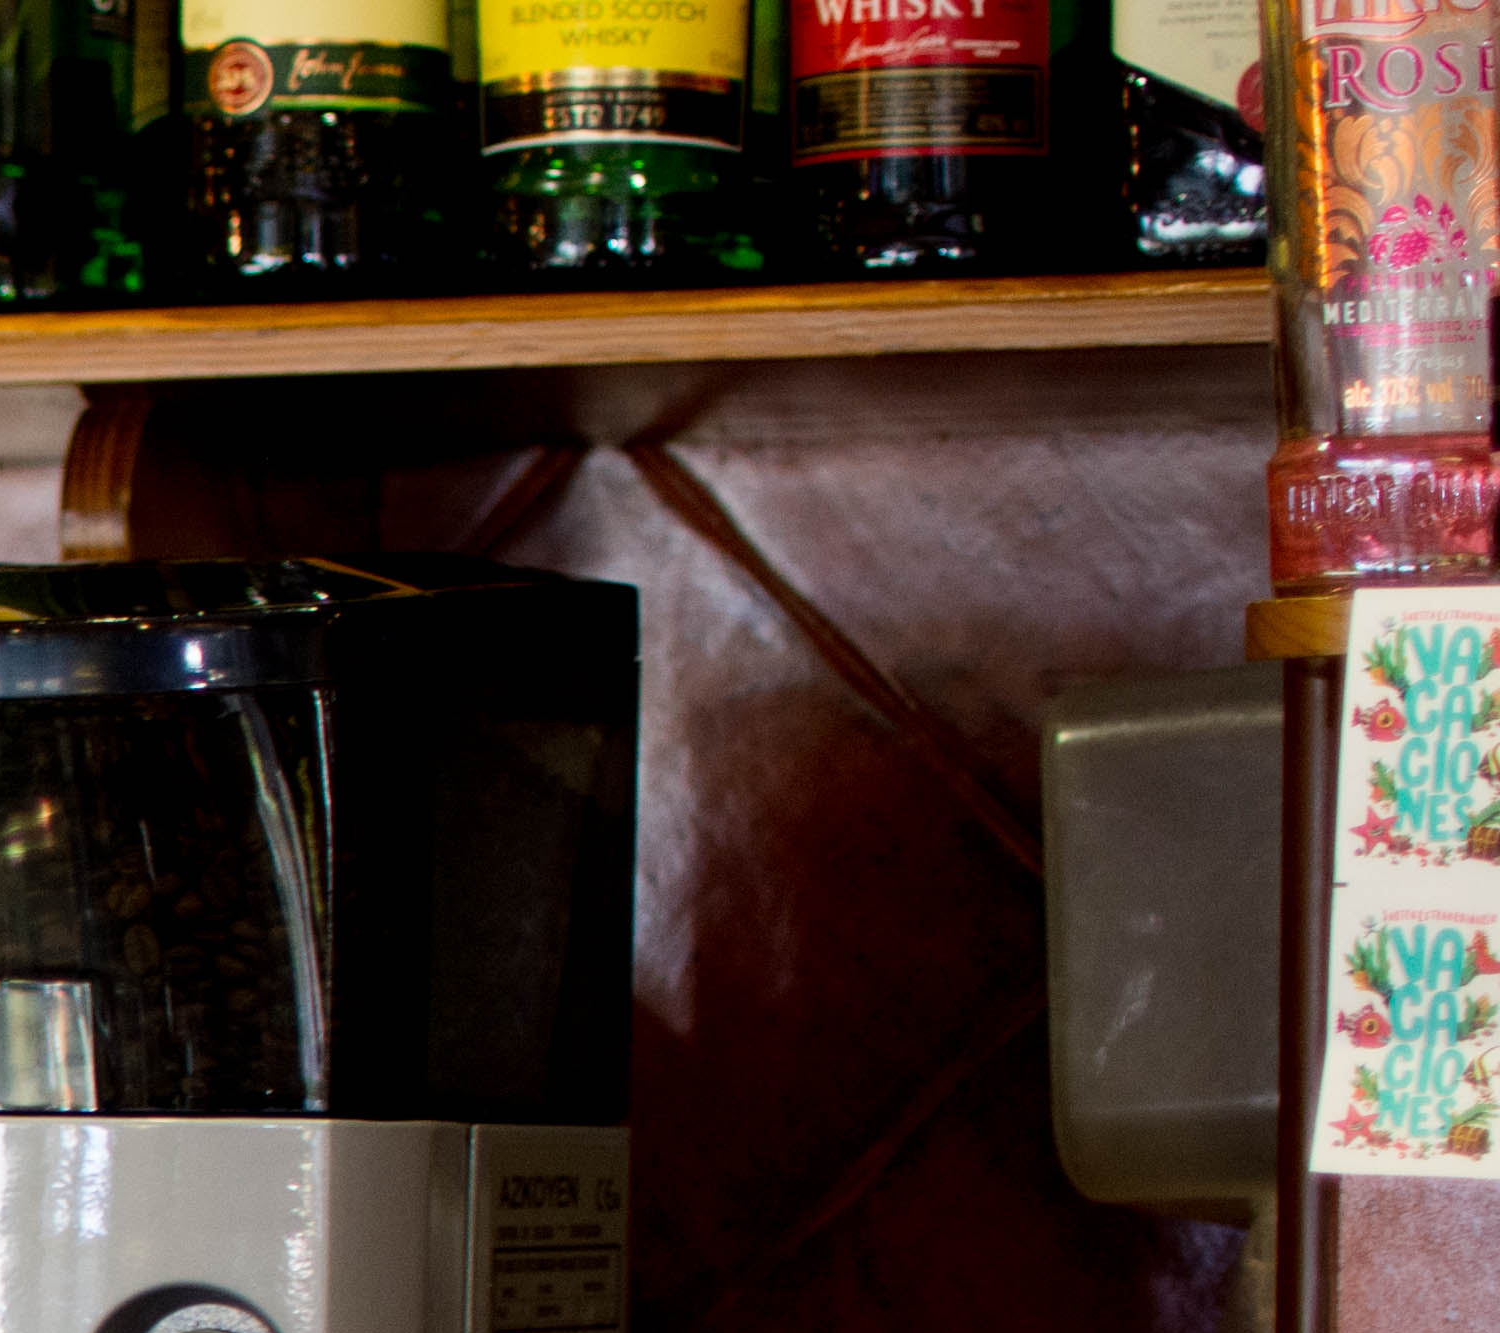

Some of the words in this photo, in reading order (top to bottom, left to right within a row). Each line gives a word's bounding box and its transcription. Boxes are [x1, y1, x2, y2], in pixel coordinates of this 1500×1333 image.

[559, 26, 652, 48] WHISKY
[1405, 623, 1481, 684] VA
[1389, 924, 1466, 990] VA
